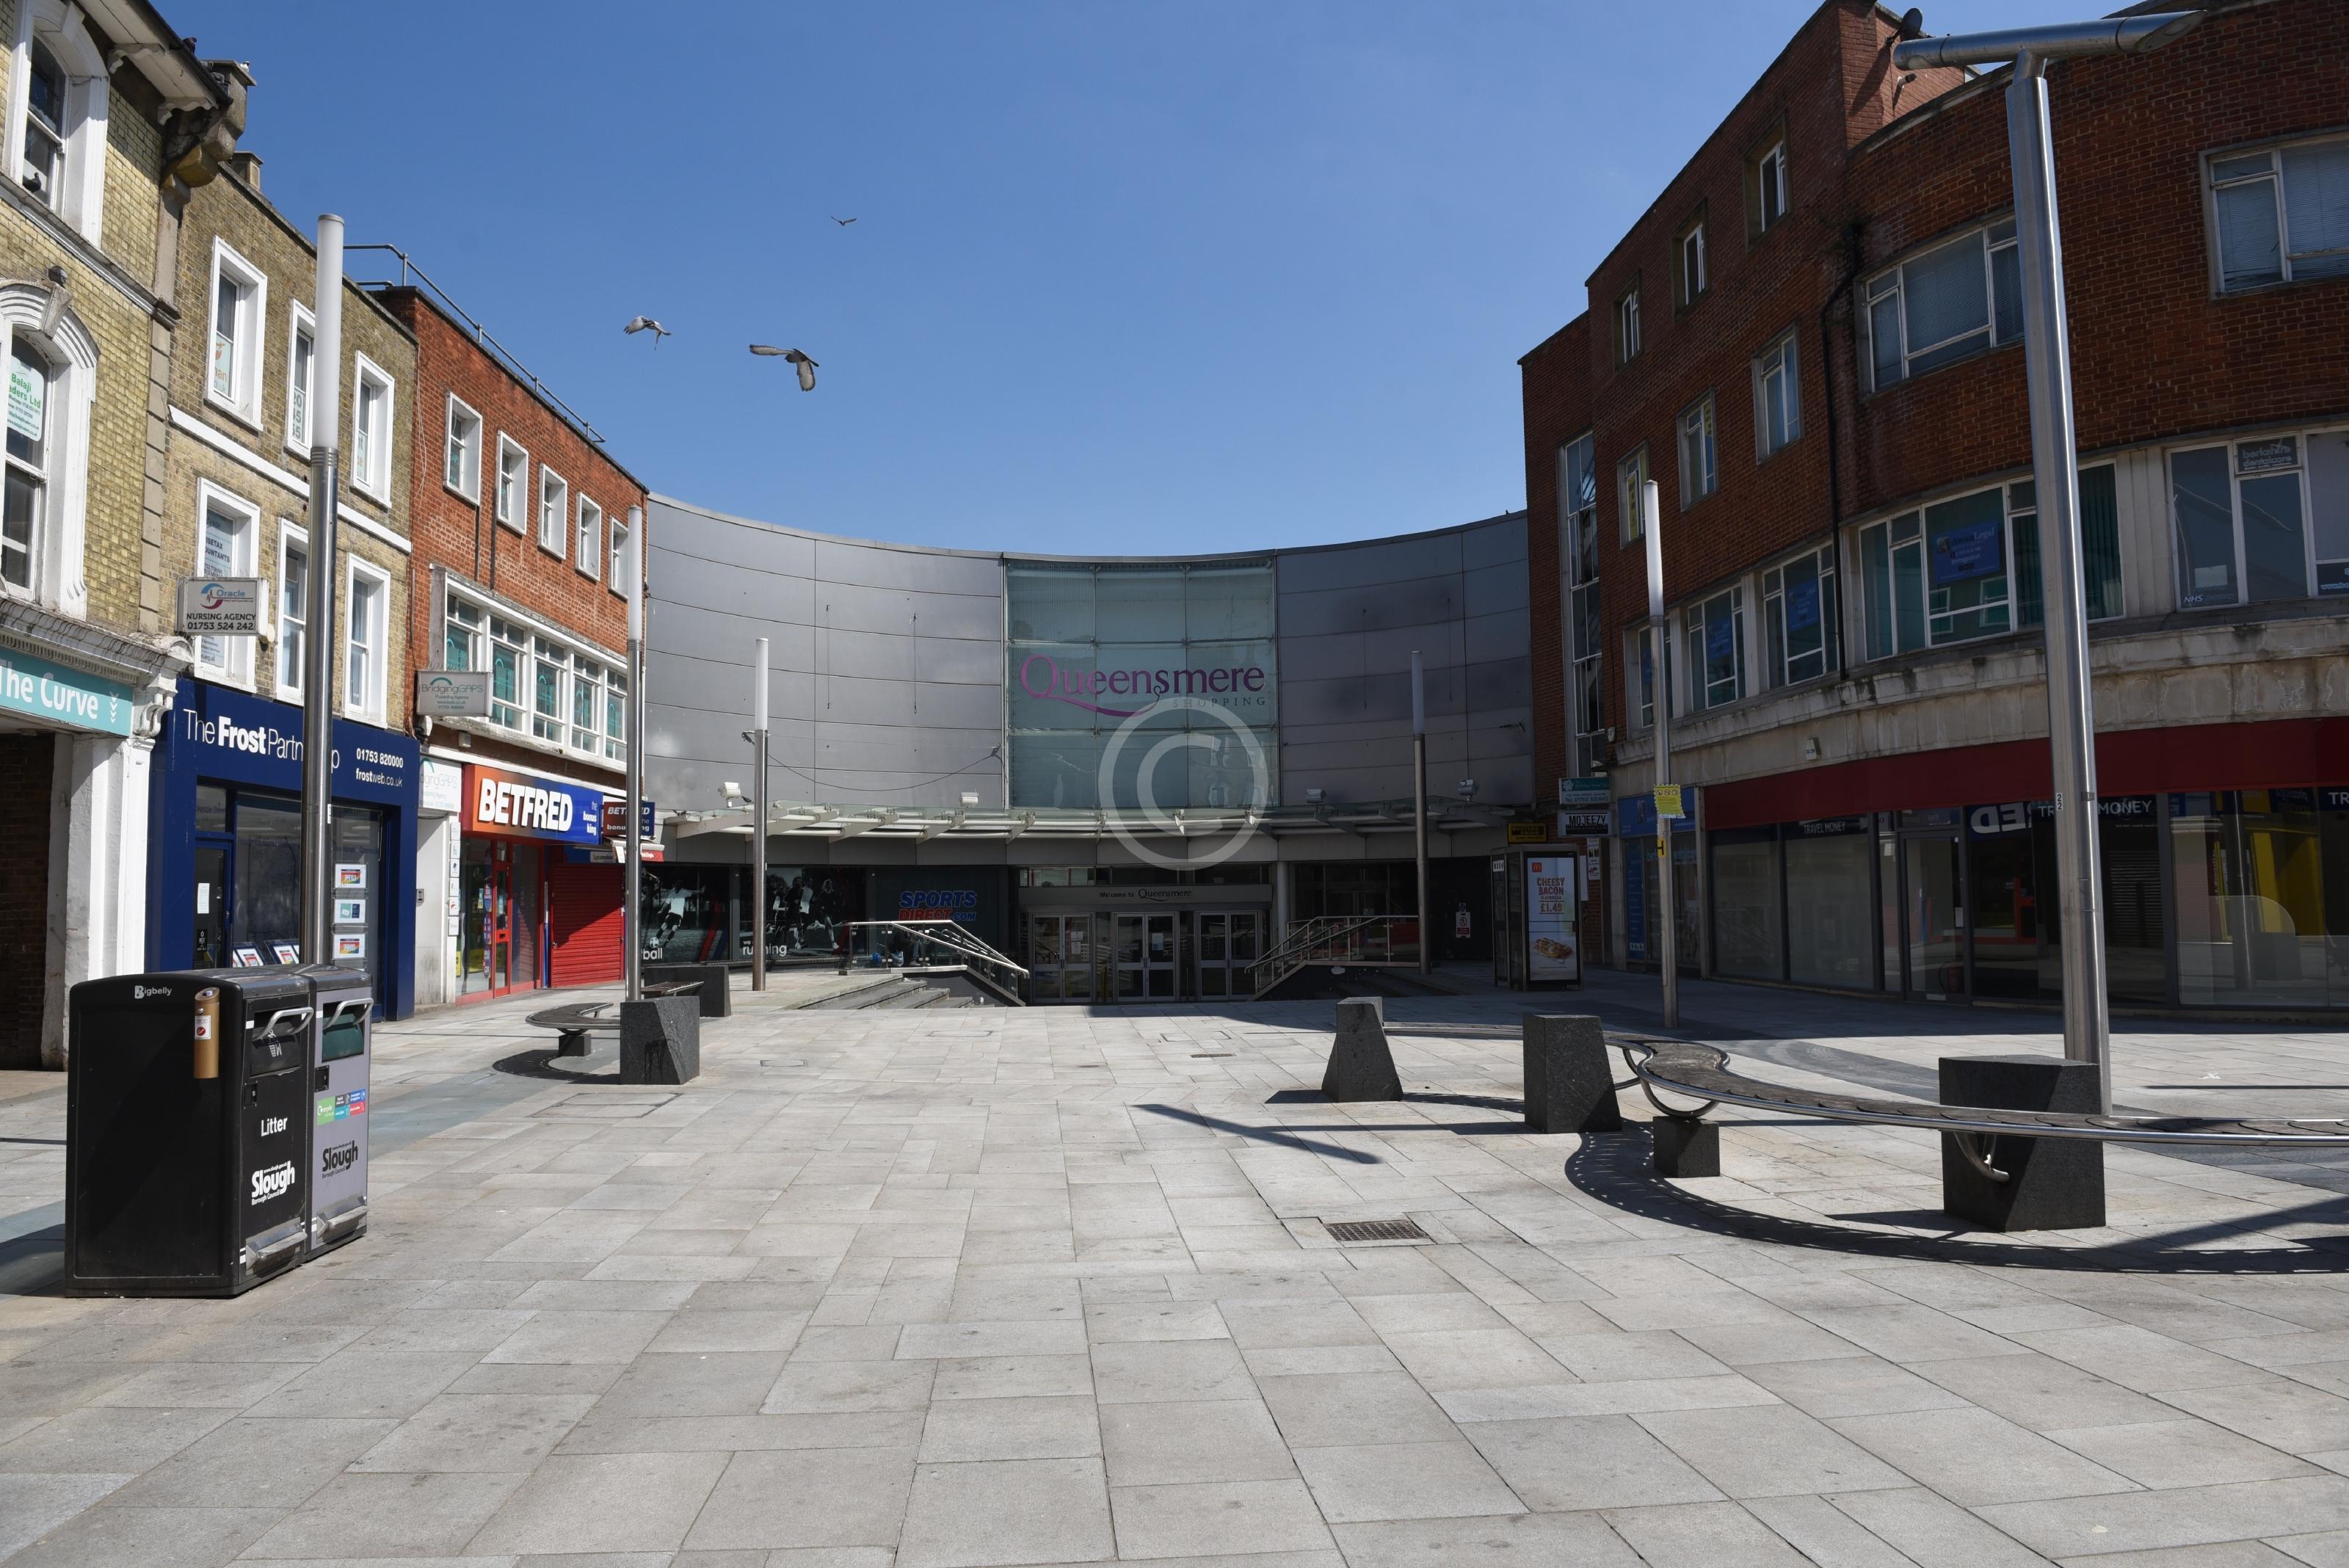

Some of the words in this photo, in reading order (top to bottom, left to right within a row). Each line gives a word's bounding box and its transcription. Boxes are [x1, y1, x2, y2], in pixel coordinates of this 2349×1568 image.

[11, 373, 32, 393] Balaji
[29, 395, 41, 409] Ltd
[216, 589, 246, 598] Oracle
[2185, 595, 2203, 603] NHS
[187, 622, 214, 630] 01753
[217, 622, 234, 630] 524
[236, 622, 254, 630] 242
[1021, 654, 1265, 717] Queensmere
[40, 672, 98, 719] Curve
[1172, 697, 1266, 708] SHOPPING
[184, 708, 216, 744] The
[218, 716, 266, 755] Frost
[356, 748, 378, 764] 01753
[380, 753, 404, 769] 820000
[356, 768, 403, 788] frostweb.co.uk
[478, 778, 573, 832] BETFRED
[2098, 799, 2153, 814] MONEY
[583, 810, 597, 822] bonus
[1569, 815, 1607, 828] MOJEEZY
[587, 823, 597, 835] king
[1803, 823, 1824, 835] TRAVEL
[1824, 821, 1845, 832] MONEY
[1537, 877, 1565, 886] CHEESY
[1138, 888, 1191, 901] Queensmere
[1539, 887, 1564, 896] BACON
[899, 890, 978, 908] SPORTS
[1540, 903, 1563, 912] £1.49
[134, 985, 173, 999] Bigbelly
[261, 1117, 288, 1137] Litter
[322, 1140, 359, 1173] Slough
[252, 1160, 295, 1198] Slough
[322, 1169, 335, 1179] Borough
[335, 1165, 346, 1175] Council
[251, 1193, 267, 1205] Borough
[266, 1188, 280, 1200] Council
